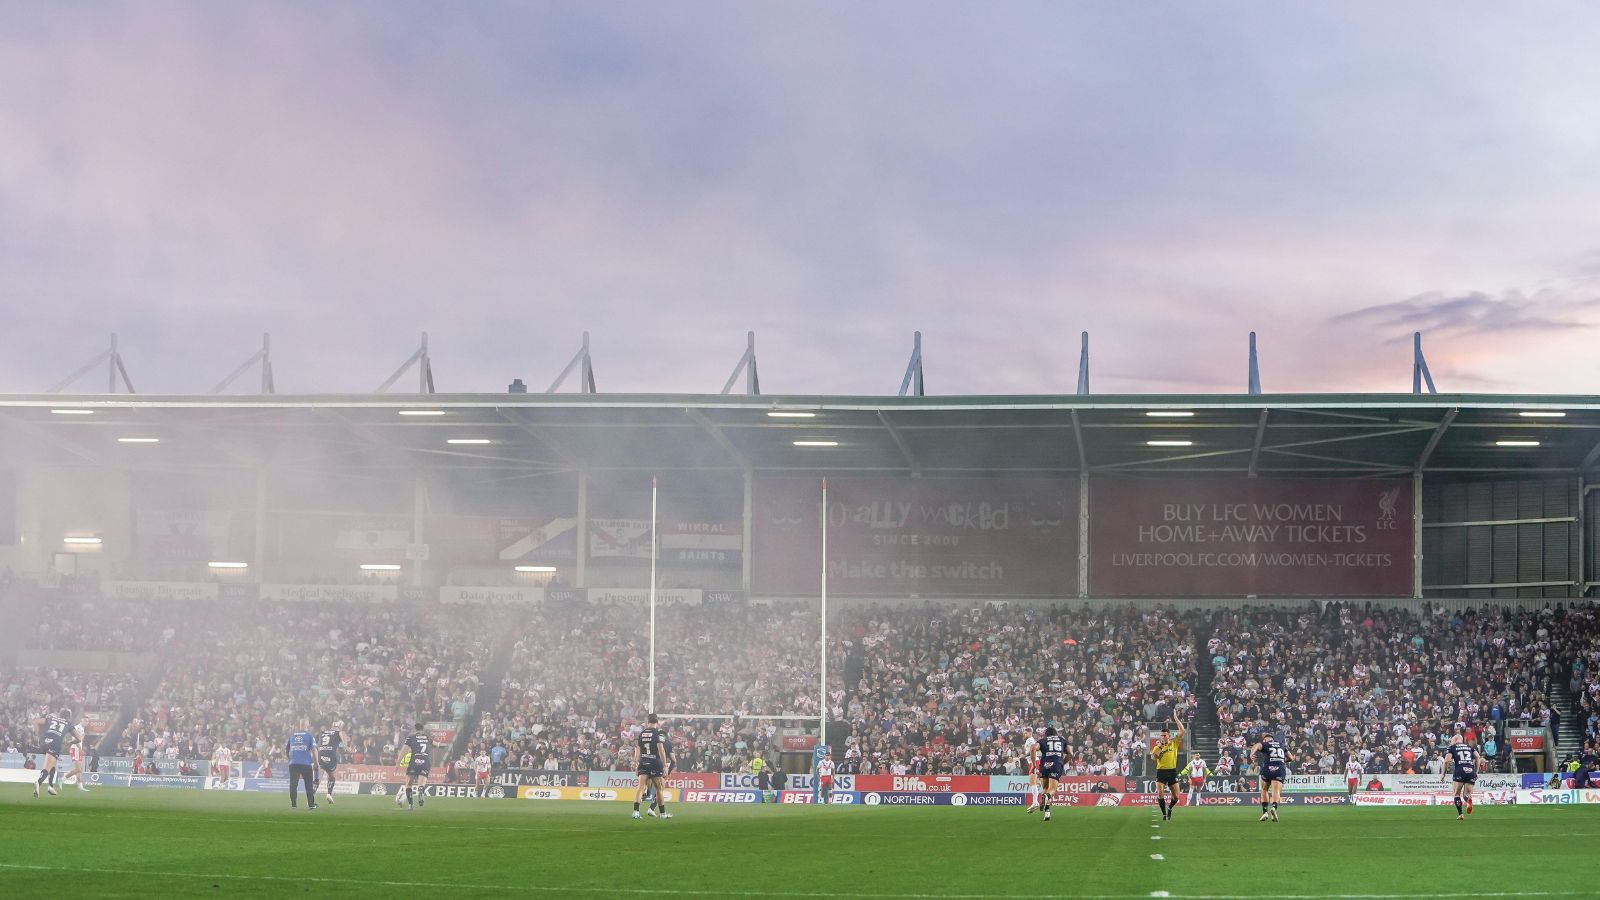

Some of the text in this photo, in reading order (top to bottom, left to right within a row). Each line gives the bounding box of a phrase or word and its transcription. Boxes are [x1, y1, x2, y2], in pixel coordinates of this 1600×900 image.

[1163, 503, 1342, 521] BUY LFC WOMEN
[677, 522, 727, 533] WIRRAL
[1376, 520, 1398, 530] LFC
[1138, 525, 1367, 543] HOME+AWAY TICKETS
[873, 534, 918, 546] SINCE
[678, 551, 726, 561] SAINTS
[1112, 552, 1393, 568] LIVERPOOLFC.COM/WOMEN-TICKETS
[828, 559, 1004, 580] Make the switch
[460, 591, 524, 600] Data Breach
[549, 590, 572, 600] SBW
[604, 592, 684, 603] Personal njury
[707, 592, 733, 602] SBW
[50, 720, 65, 732] 21
[322, 736, 330, 745] 9
[1047, 741, 1062, 751] 16
[420, 743, 427, 752] 7
[644, 743, 651, 754] 1
[1268, 747, 1284, 758] 20
[1457, 750, 1471, 760] 12
[340, 770, 387, 780] Turmeric
[1313, 775, 1326, 784] Lift
[607, 776, 704, 789] home rgains
[435, 785, 478, 798] BEER
[686, 791, 756, 803] BETFRED
[1529, 788, 1581, 804] Small
[784, 793, 854, 804] BETED
[884, 796, 935, 804] NORTHERN
[971, 797, 1021, 805] NORTHERN
